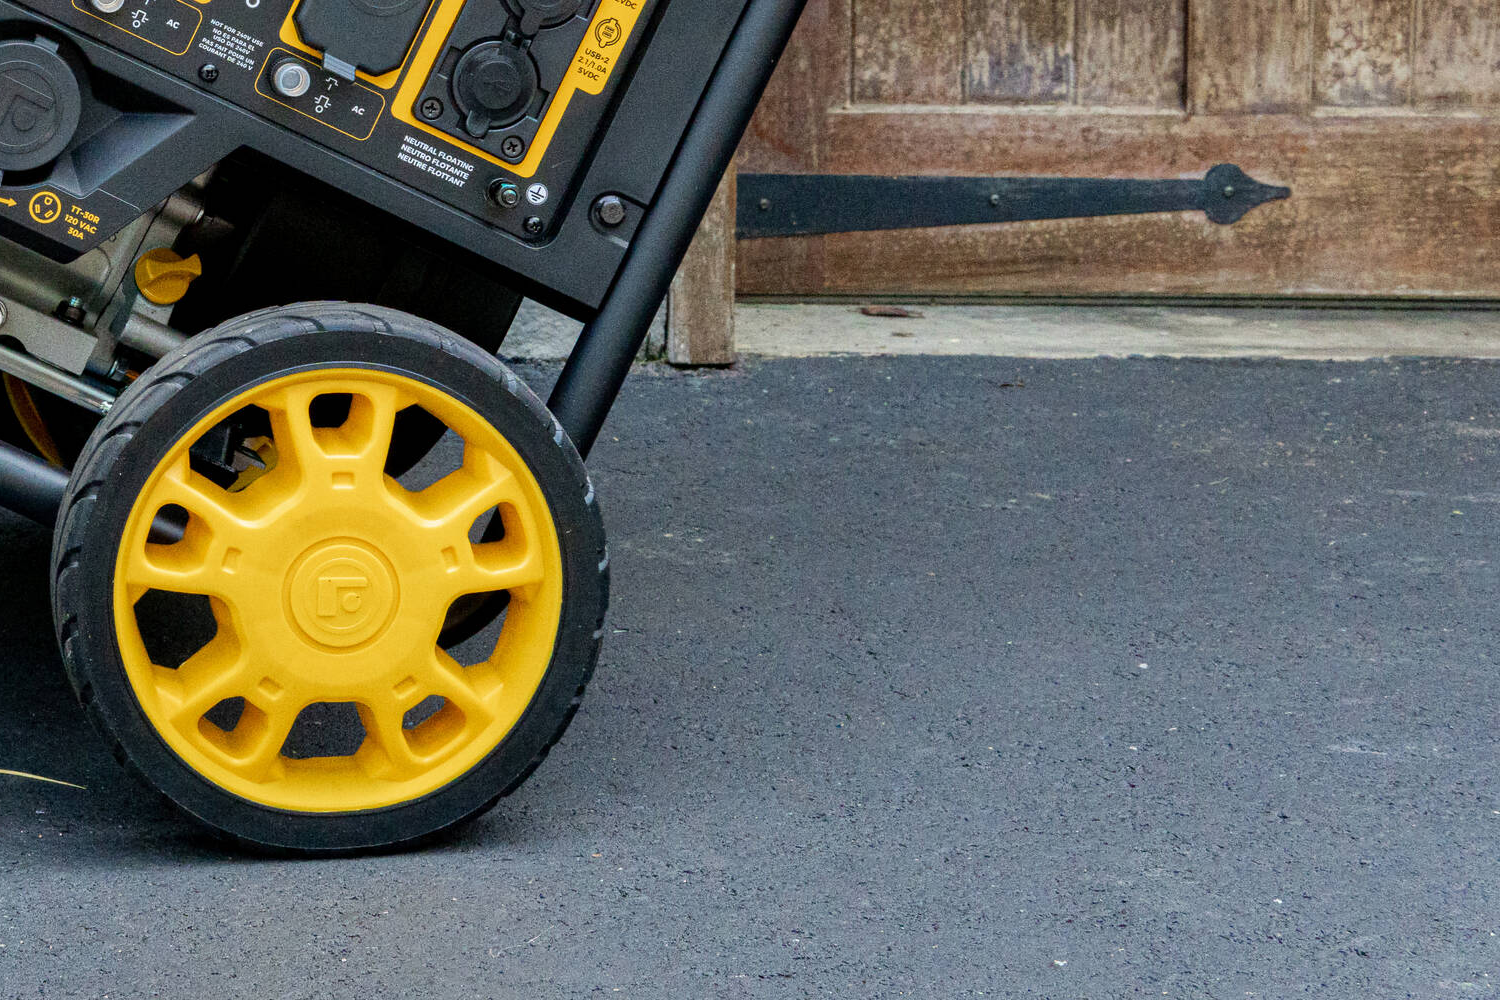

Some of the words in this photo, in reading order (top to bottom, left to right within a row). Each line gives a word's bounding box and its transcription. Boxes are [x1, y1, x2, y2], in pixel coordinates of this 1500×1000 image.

[166, 18, 180, 29] AC
[210, 19, 223, 28] NOT
[223, 25, 236, 34] FOR
[236, 31, 250, 41] 240V
[251, 38, 263, 47] USE
[212, 28, 222, 36] NO
[231, 36, 247, 47] PARA
[212, 35, 225, 43] USO
[234, 45, 250, 55] 240V
[198, 42, 226, 58] COURANT
[225, 55, 236, 63] DE
[202, 38, 214, 46] PAS
[214, 43, 229, 53] FAIT
[228, 50, 245, 60] POUR
[244, 57, 254, 65] UN
[577, 67, 599, 81] 5VDC
[351, 105, 365, 115] AC
[401, 144, 431, 162] NEUTRO
[431, 158, 469, 179] FLOTANTE
[404, 135, 438, 155] NEUTRAL
[438, 151, 474, 172] FLOATING
[397, 152, 427, 170] NEUTRE
[427, 166, 465, 187] FLOTTANT
[64, 214, 78, 225] 120
[78, 221, 97, 234] VAC
[70, 205, 100, 224] TT-30R
[67, 227, 85, 240] 30A
